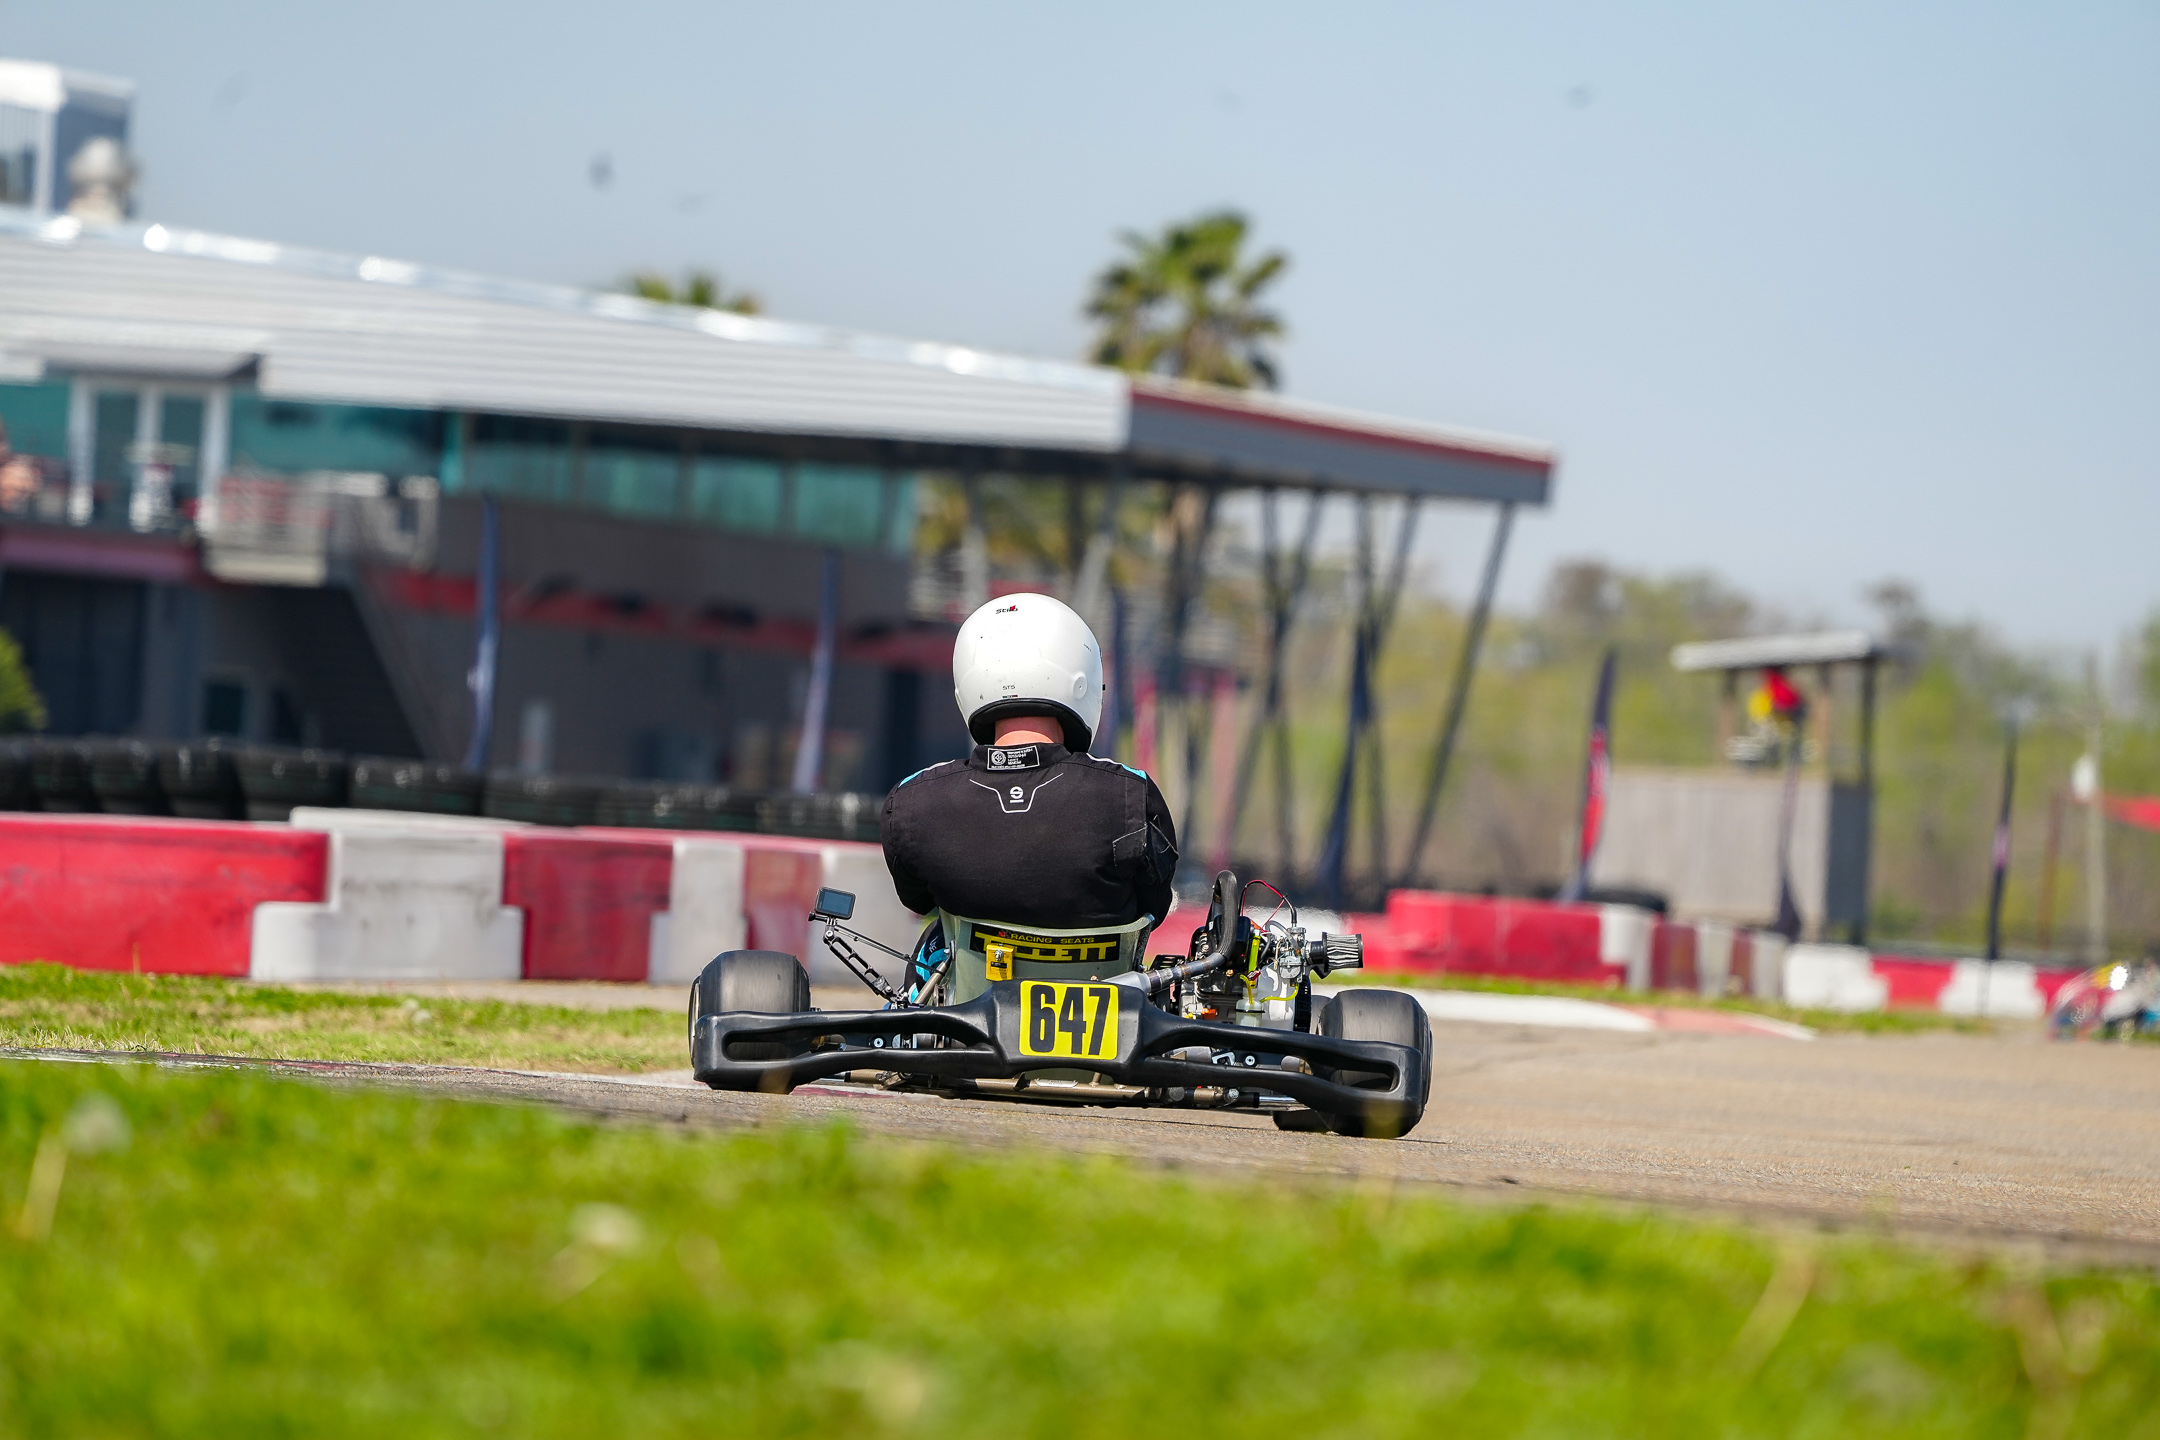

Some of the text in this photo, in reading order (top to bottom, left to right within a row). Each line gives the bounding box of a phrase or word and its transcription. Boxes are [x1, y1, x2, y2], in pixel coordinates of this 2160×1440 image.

[974, 931, 1117, 961] TLLETT
[1010, 933, 1053, 944] RACING
[1029, 984, 1111, 1056] 647
